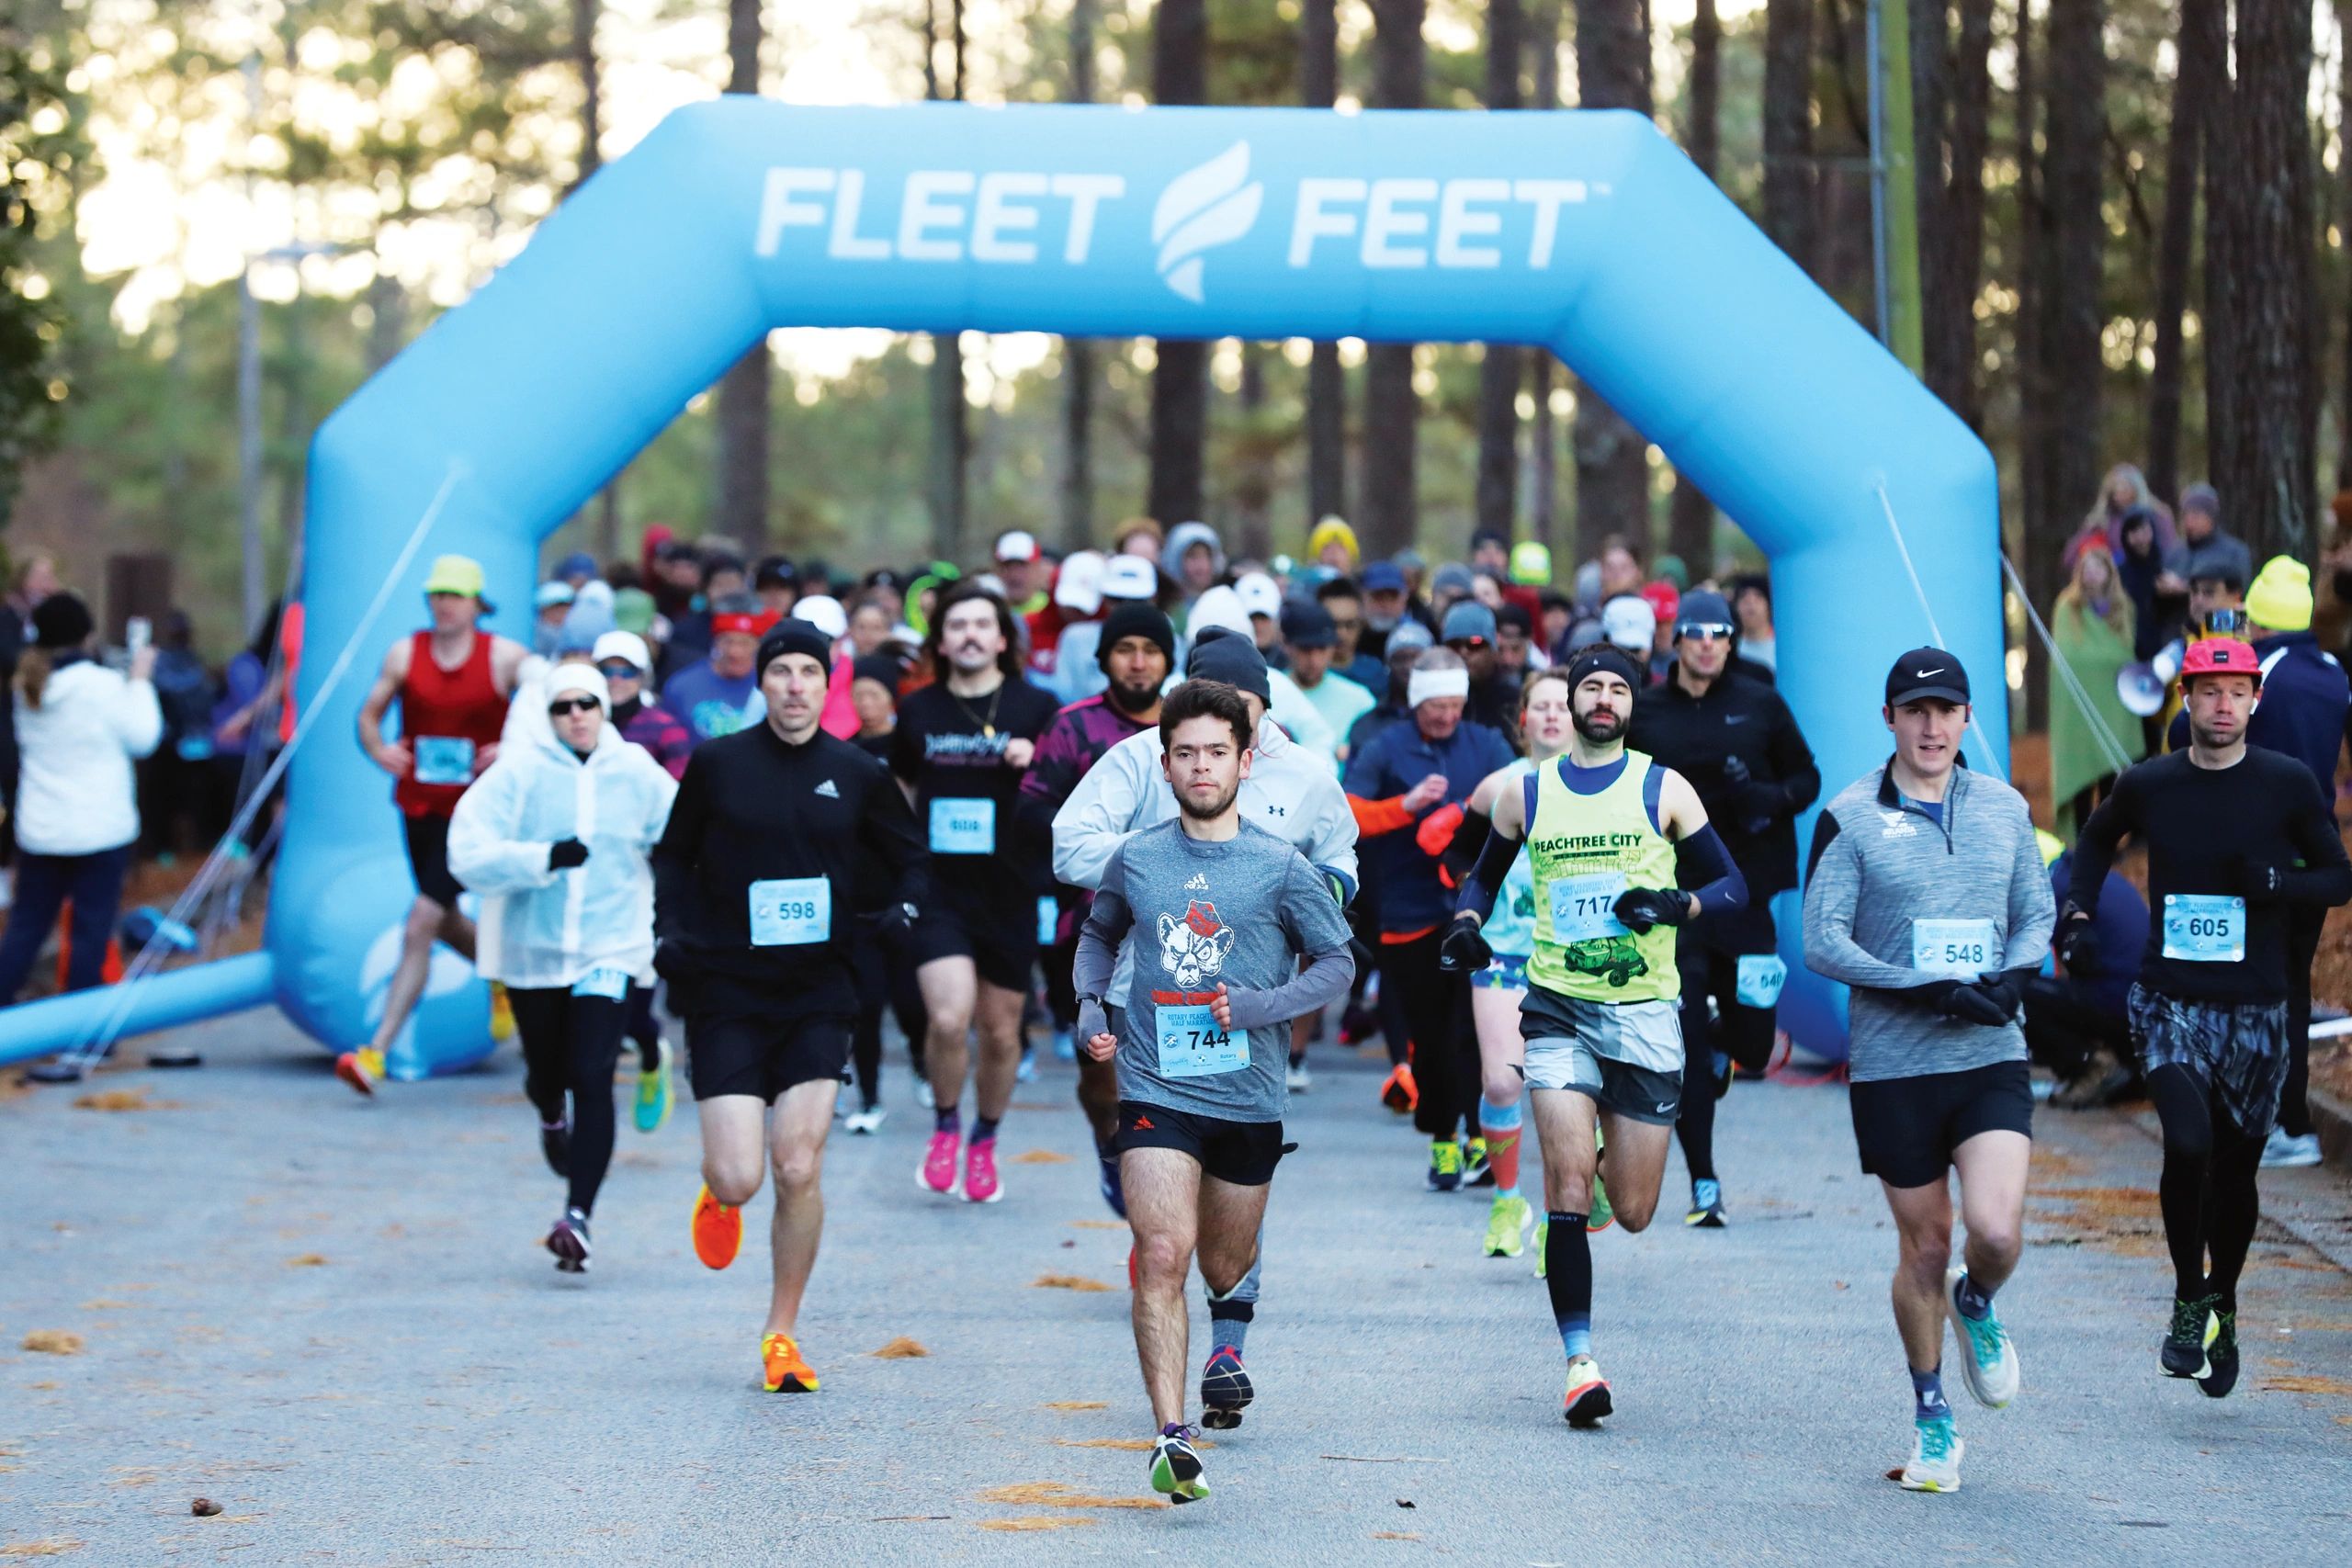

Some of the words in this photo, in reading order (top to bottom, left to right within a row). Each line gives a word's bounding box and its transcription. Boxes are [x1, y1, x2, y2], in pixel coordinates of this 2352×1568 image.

[754, 167, 1126, 265] FLEET
[1287, 178, 1588, 269] FEET
[1534, 835, 1606, 853] PEACHTREE
[1611, 834, 1642, 847] CITY
[779, 902, 815, 919] 598
[1575, 896, 1611, 916] 717
[2190, 919, 2229, 936] 605
[1946, 944, 1983, 964] 548
[1187, 1030, 1231, 1050] 744
